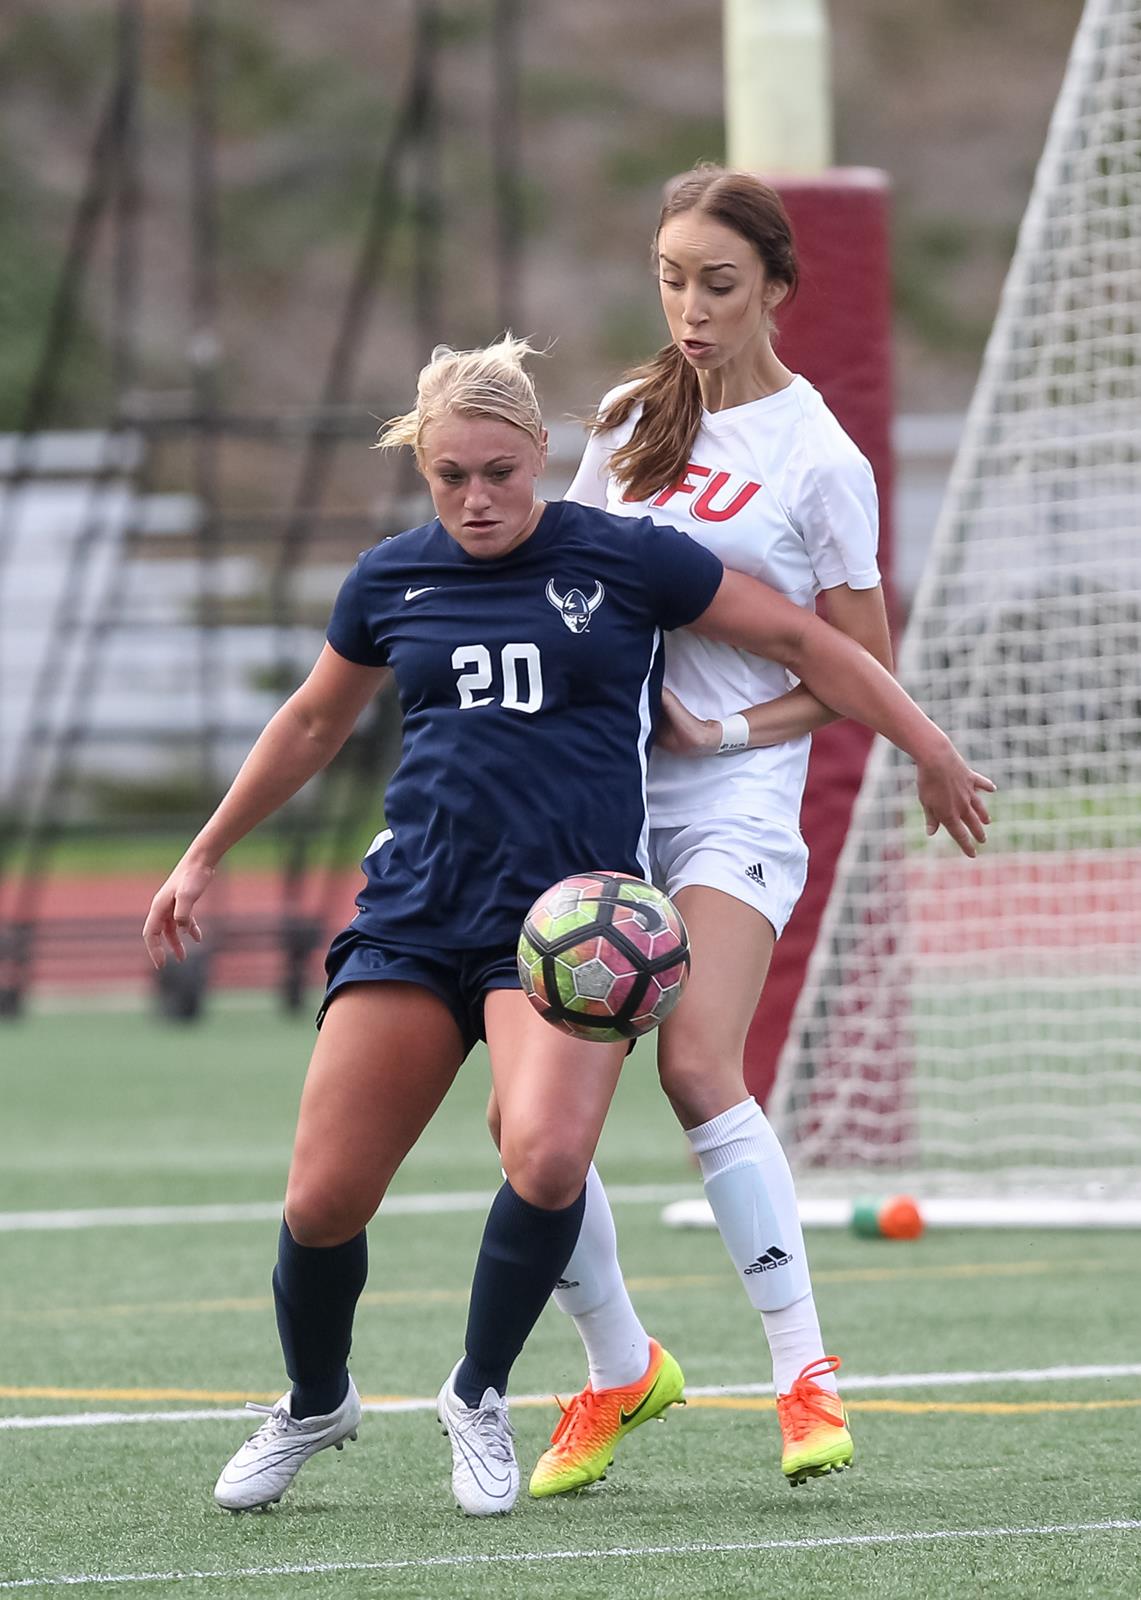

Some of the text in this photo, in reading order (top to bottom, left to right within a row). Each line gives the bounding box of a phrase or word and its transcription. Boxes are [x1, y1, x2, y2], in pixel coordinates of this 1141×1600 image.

[619, 463, 762, 523] FU
[451, 643, 543, 713] 20
[743, 1254, 793, 1275] adidas
